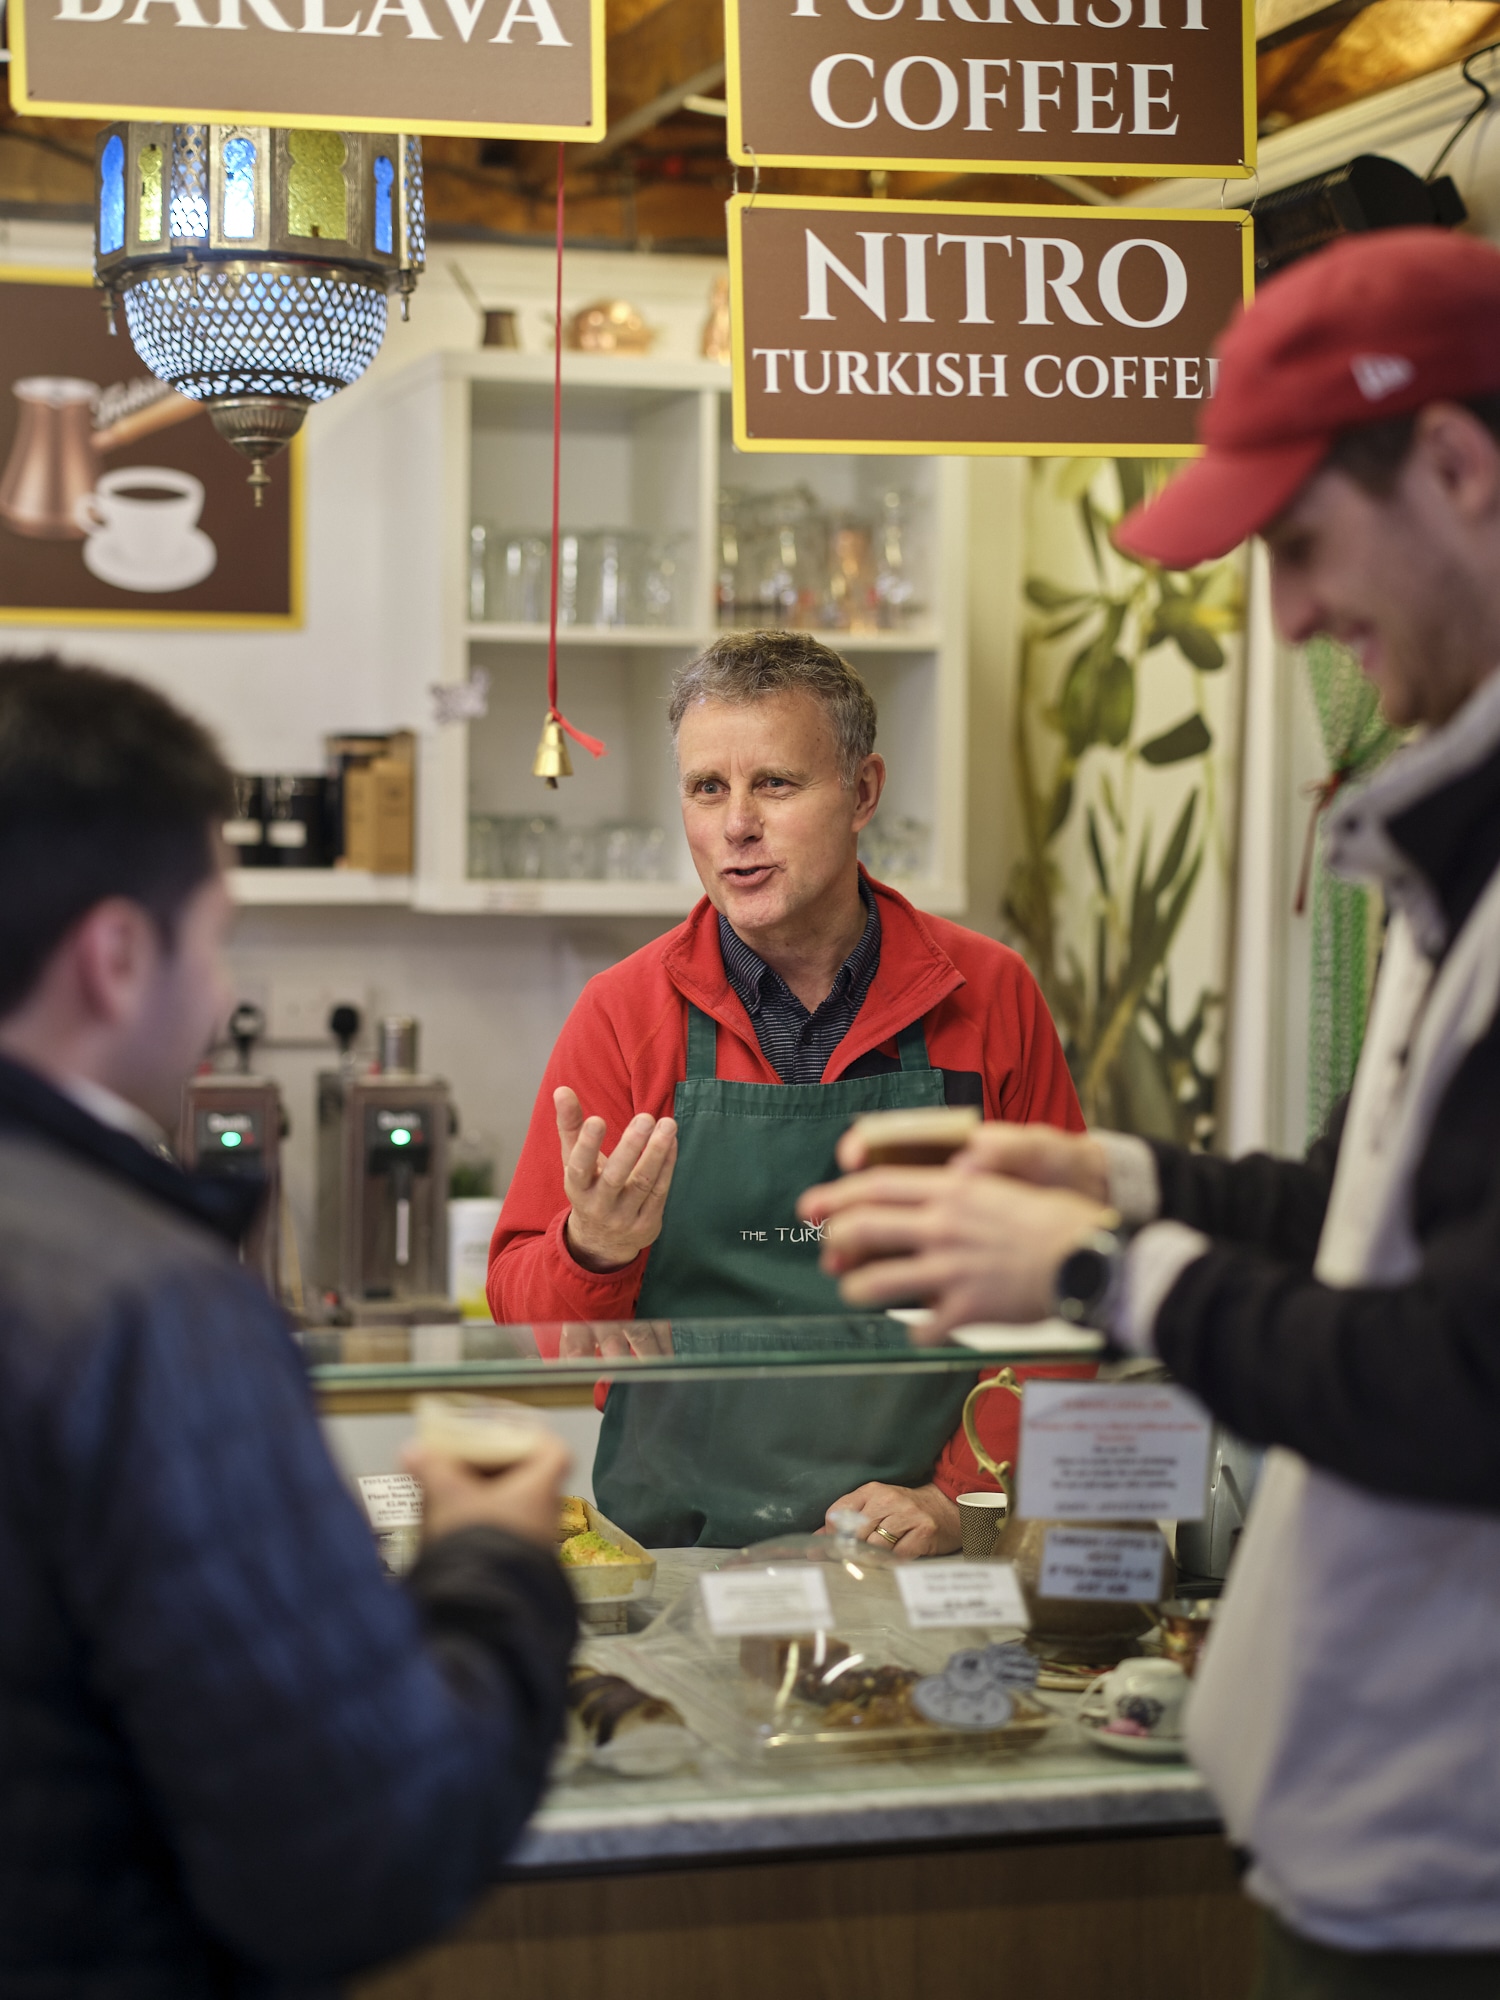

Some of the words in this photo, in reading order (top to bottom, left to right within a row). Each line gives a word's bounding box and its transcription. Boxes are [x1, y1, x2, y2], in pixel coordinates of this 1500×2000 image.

[810, 53, 1179, 135] COFFEE
[800, 228, 1187, 328] NITRO
[752, 348, 1009, 397] TURKISH
[740, 1231, 768, 1242] THE
